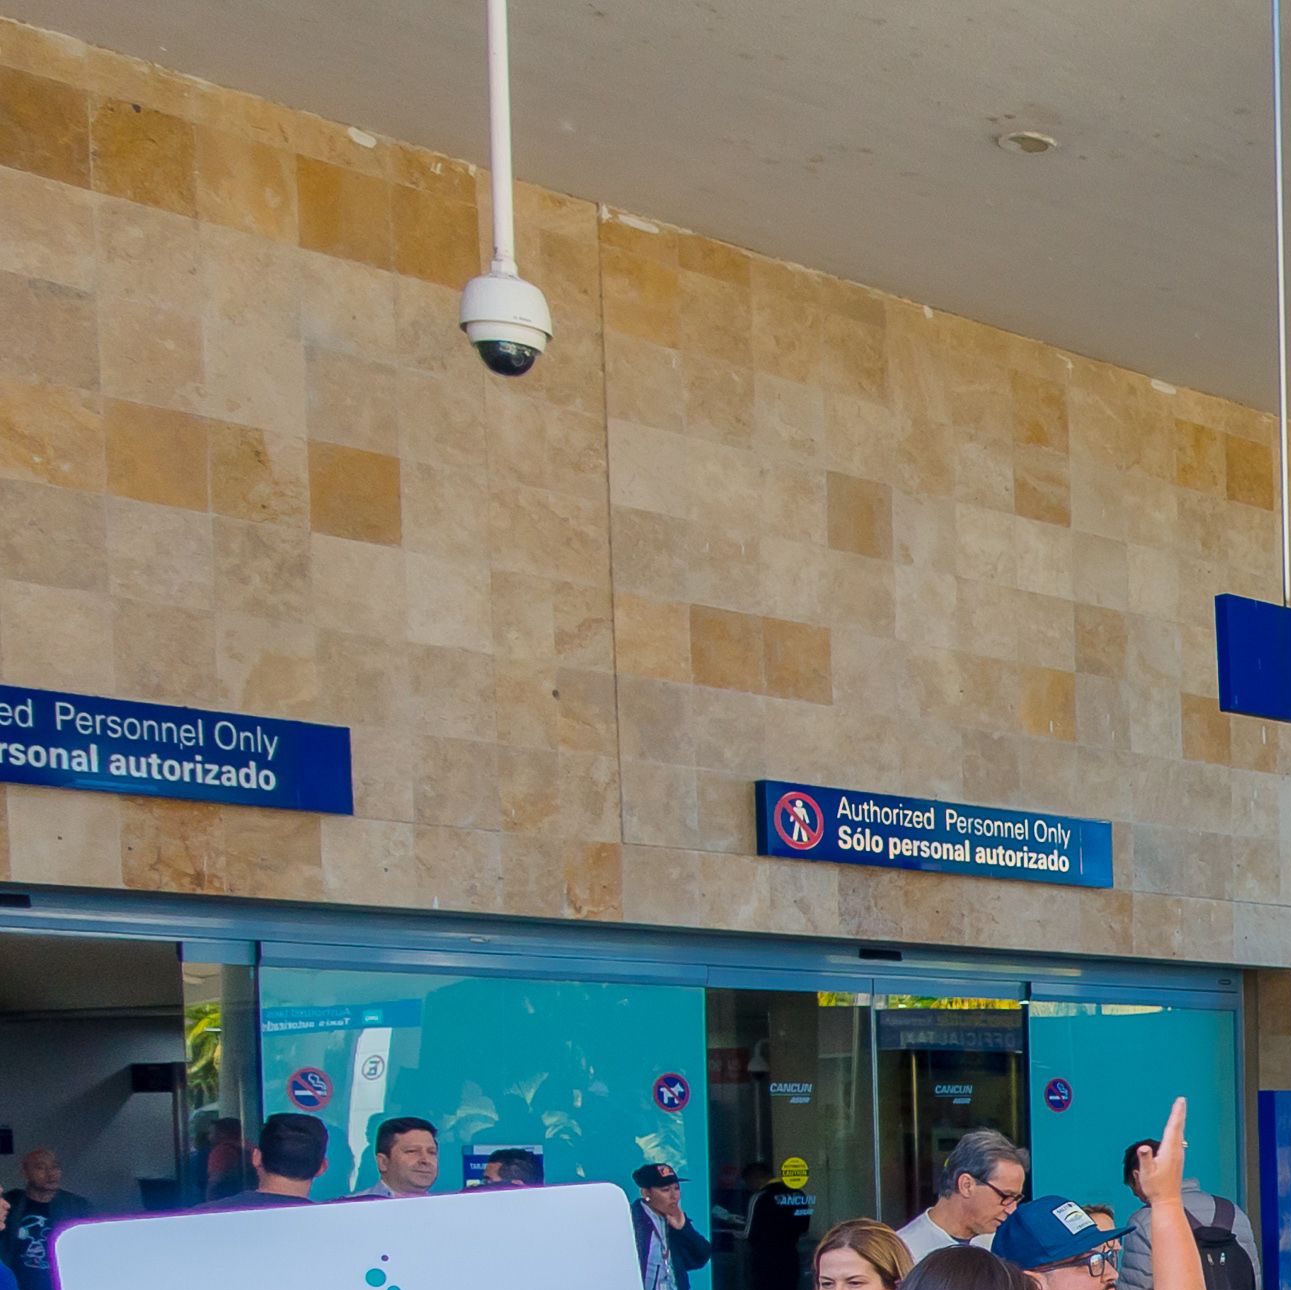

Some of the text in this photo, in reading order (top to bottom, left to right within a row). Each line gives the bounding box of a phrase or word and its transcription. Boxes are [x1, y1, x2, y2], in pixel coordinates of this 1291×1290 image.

[55, 701, 204, 747] Personnel
[214, 721, 279, 761] Only
[0, 742, 277, 791] rsonal autorizado
[837, 796, 1071, 849] Authorized Personnel Only
[838, 825, 1070, 872] Sólo personal autorizado
[769, 1082, 813, 1094] CANCUN
[934, 1084, 974, 1095] CANCUN
